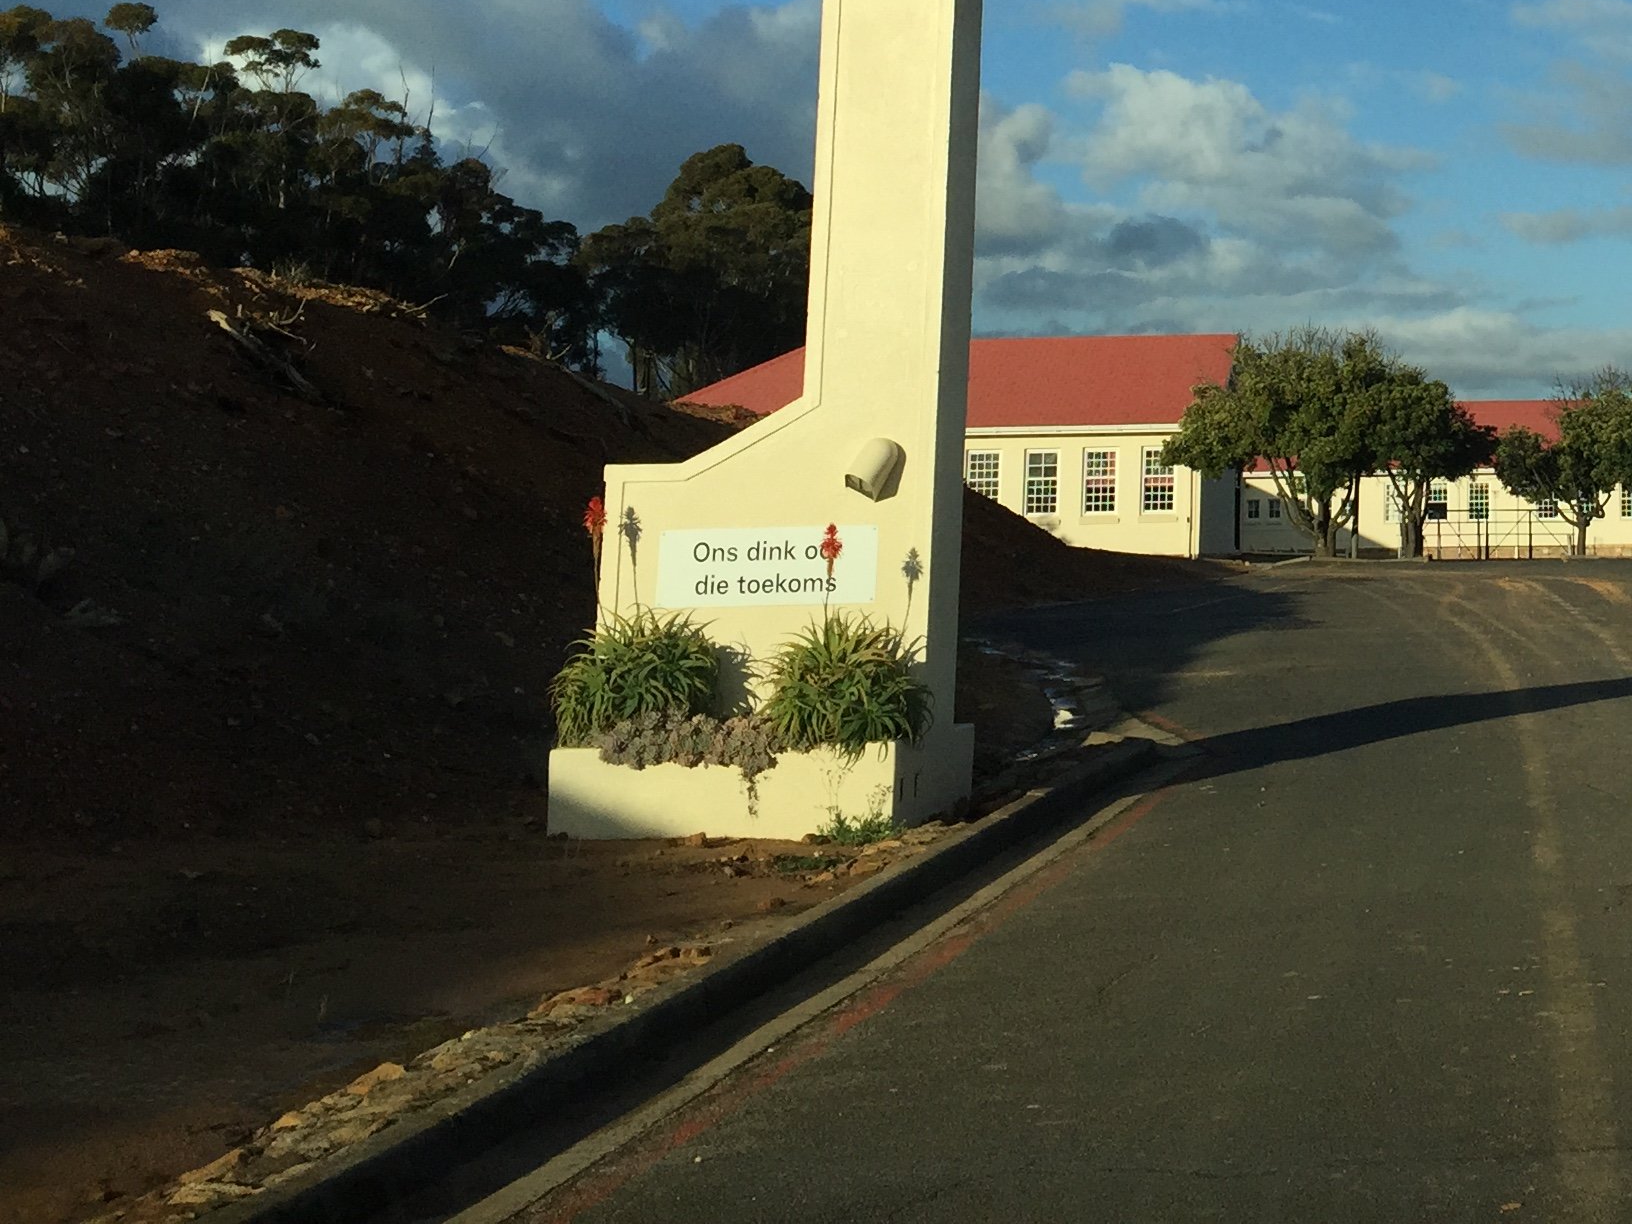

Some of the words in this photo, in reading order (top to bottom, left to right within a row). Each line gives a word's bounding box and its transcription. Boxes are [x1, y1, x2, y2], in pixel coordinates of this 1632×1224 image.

[694, 542, 737, 562] Ons
[747, 541, 795, 561] dink
[695, 575, 728, 595] die
[736, 572, 837, 594] toekoms
